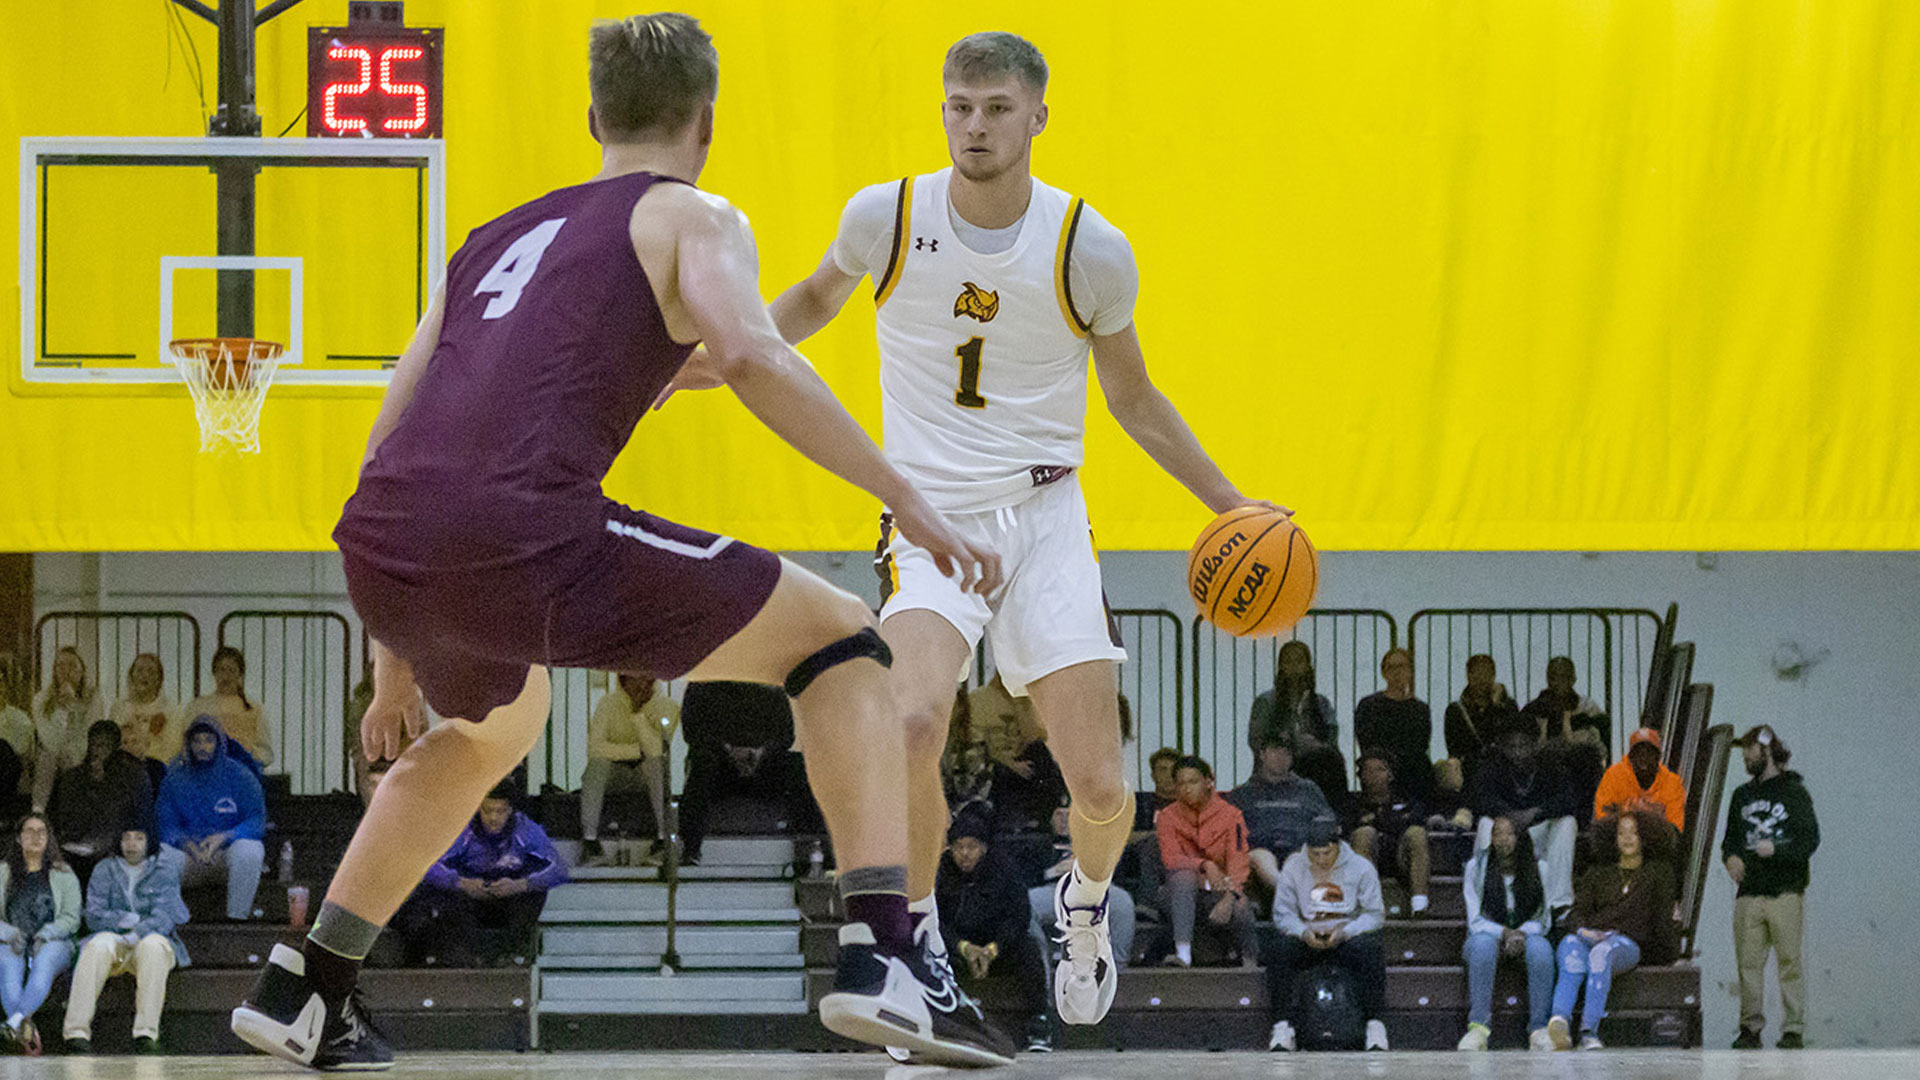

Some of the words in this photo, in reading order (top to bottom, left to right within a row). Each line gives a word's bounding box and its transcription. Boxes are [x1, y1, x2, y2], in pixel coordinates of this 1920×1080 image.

[323, 45, 428, 131] 25
[473, 217, 568, 320] 4
[954, 336, 987, 409] 1
[1193, 531, 1248, 604] Wilson
[1227, 561, 1271, 619] NCAA
